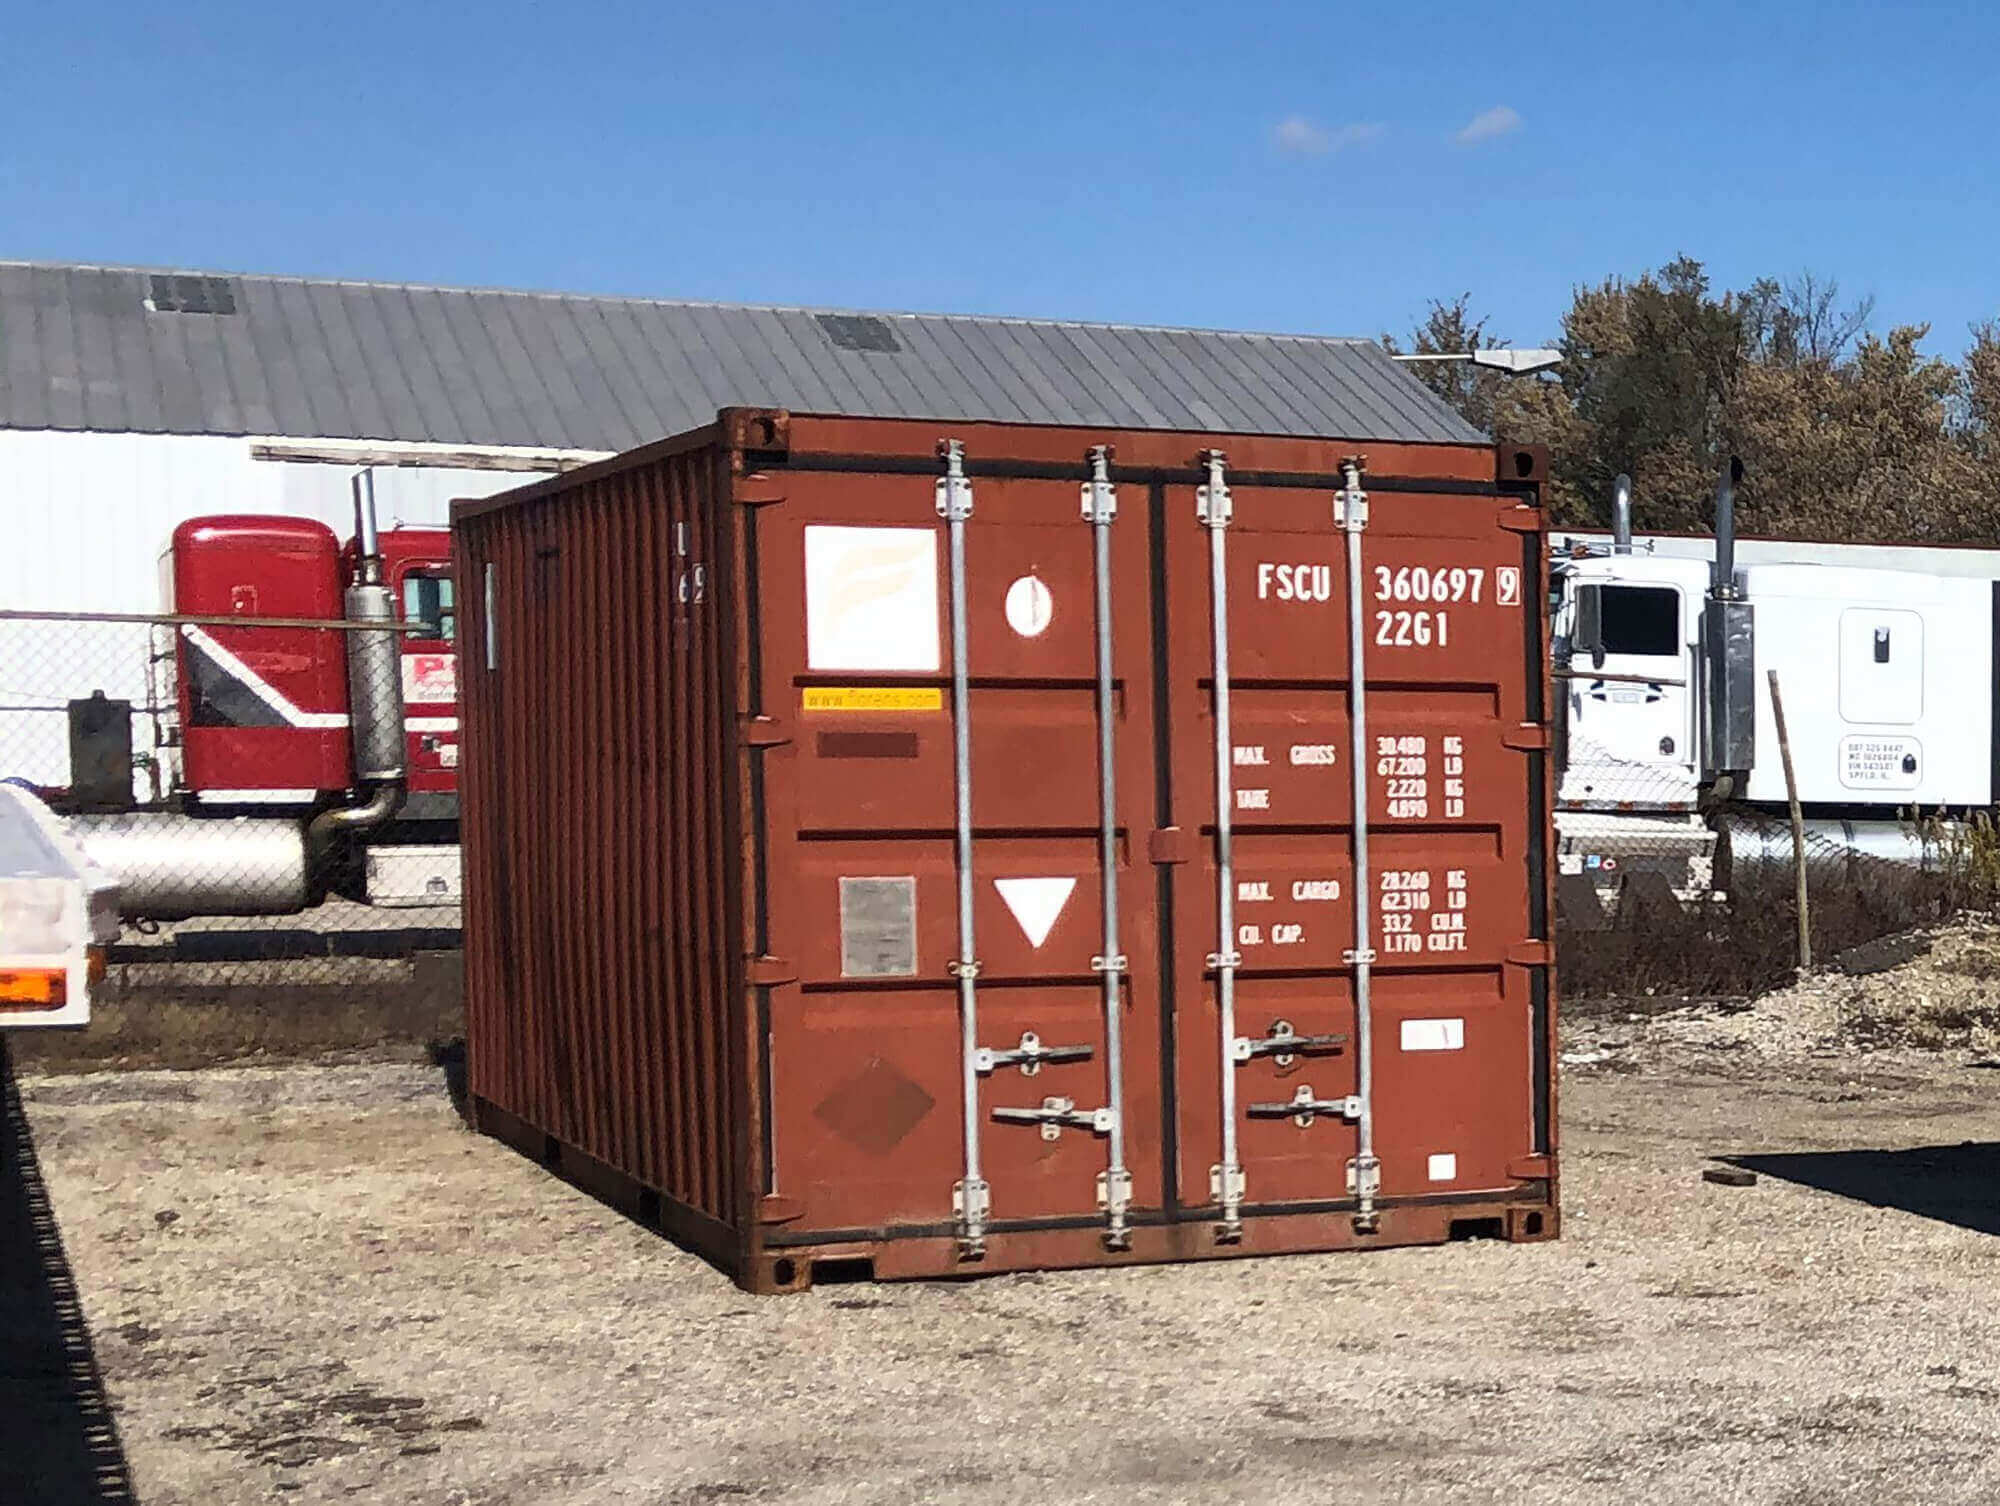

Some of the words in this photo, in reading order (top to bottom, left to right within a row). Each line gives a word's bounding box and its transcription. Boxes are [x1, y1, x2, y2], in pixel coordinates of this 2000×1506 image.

[1258, 563, 1330, 601] FSCU
[1374, 566, 1484, 602] 360697
[1498, 568, 1517, 603] 9
[1375, 611, 1447, 646] 22G1
[1290, 745, 1335, 765] GROSS
[1443, 736, 1463, 755] KG
[1444, 757, 1463, 775] LB
[1445, 779, 1464, 797] KG
[1446, 799, 1464, 818] LB
[1447, 870, 1466, 889] KG
[1293, 881, 1339, 900] CARGO
[1447, 890, 1467, 909] LB
